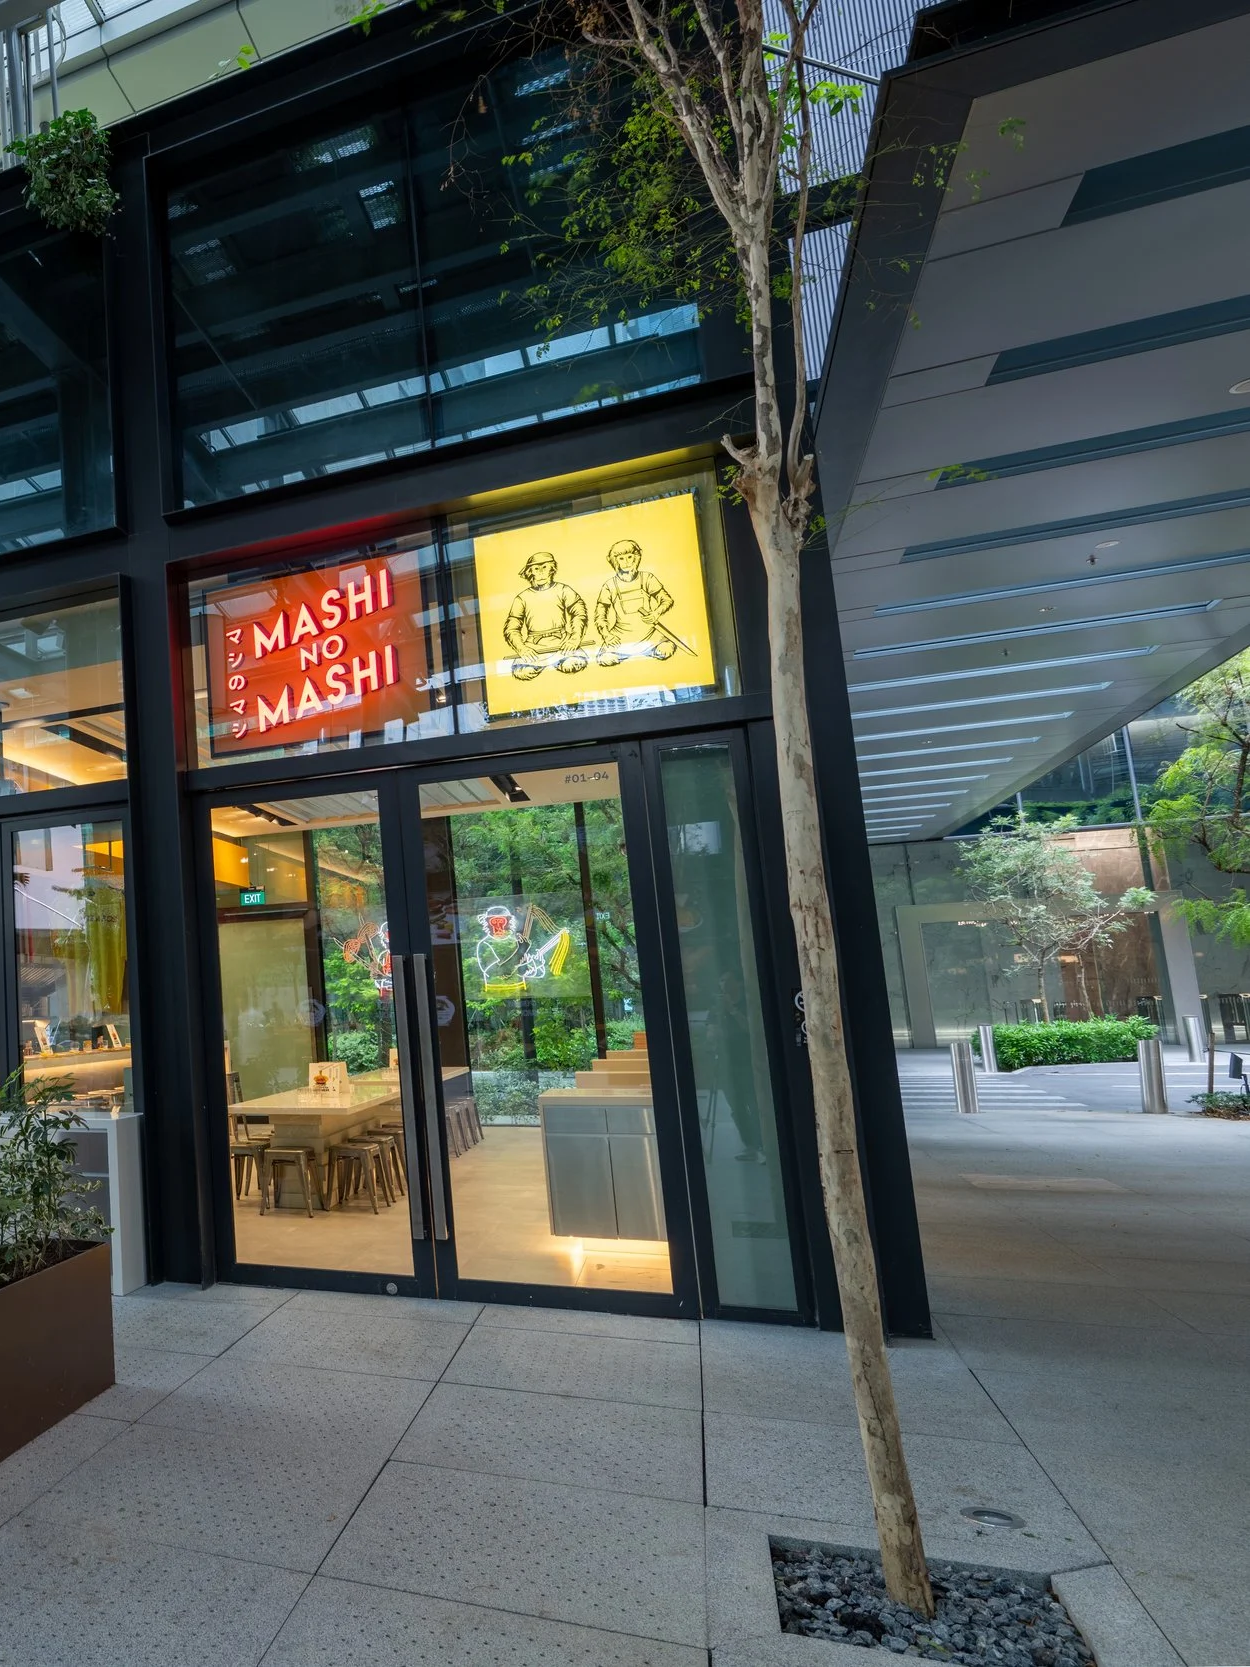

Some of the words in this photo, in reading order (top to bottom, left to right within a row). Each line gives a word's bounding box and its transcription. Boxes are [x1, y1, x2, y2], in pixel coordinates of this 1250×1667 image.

[253, 569, 392, 660] MASHI
[226, 628, 247, 739] マシのマシ
[300, 634, 346, 671] NO
[257, 644, 398, 733] MASHI
[565, 771, 609, 784] #01-04
[244, 893, 261, 904] EXIT
